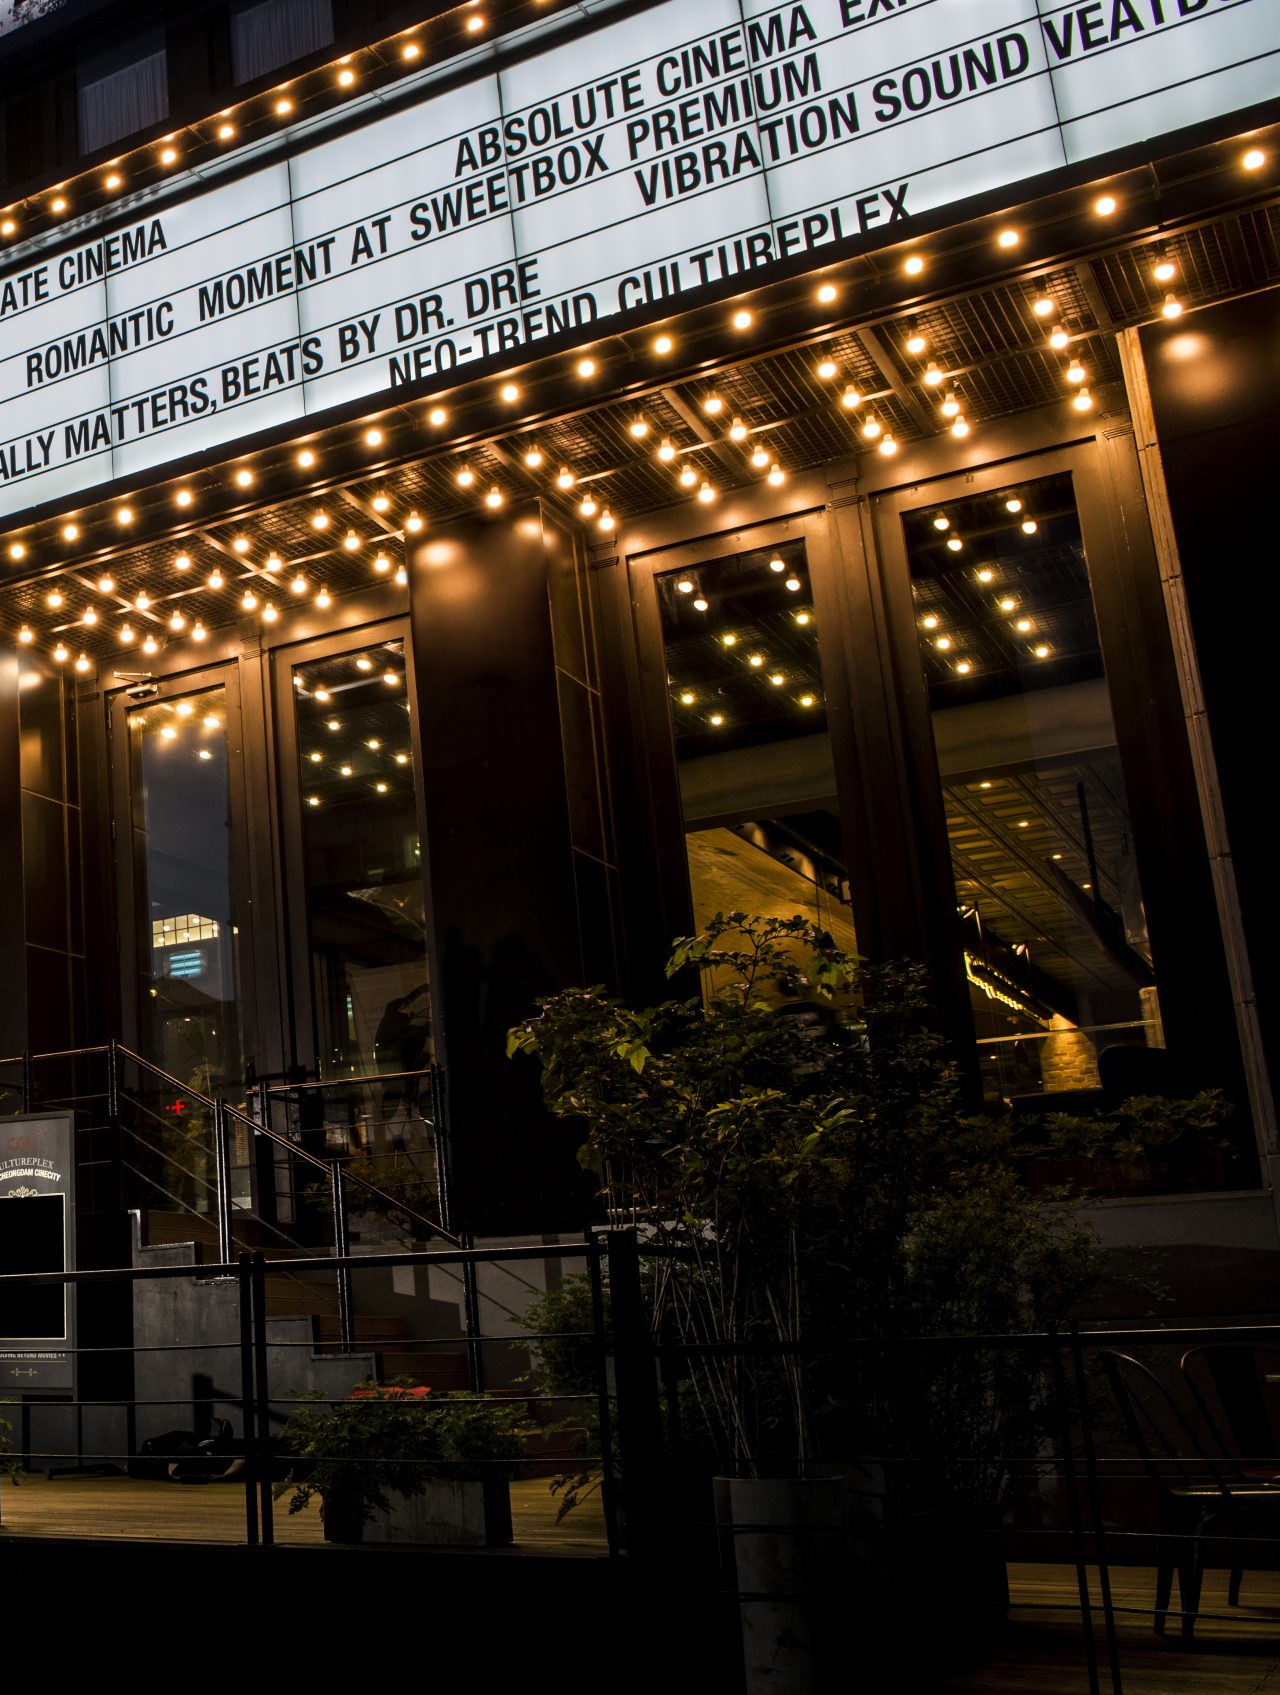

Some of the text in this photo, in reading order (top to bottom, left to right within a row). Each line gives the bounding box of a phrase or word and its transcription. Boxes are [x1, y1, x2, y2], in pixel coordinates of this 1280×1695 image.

[455, 4, 817, 178] ABSOLUTE CINEMA
[634, 92, 860, 206] VIBRATION
[872, 32, 1030, 123] SOUND
[26, 52, 822, 387] ROMANTIC MOMENT AT SWEETBOX PREMIUM
[58, 218, 168, 291] CINEMA
[618, 183, 911, 311] CULTUREPLEX
[338, 314, 381, 363] BY
[395, 295, 454, 342] DR.
[466, 258, 541, 319] DRE
[34, 1168, 61, 1182] CINECITY
